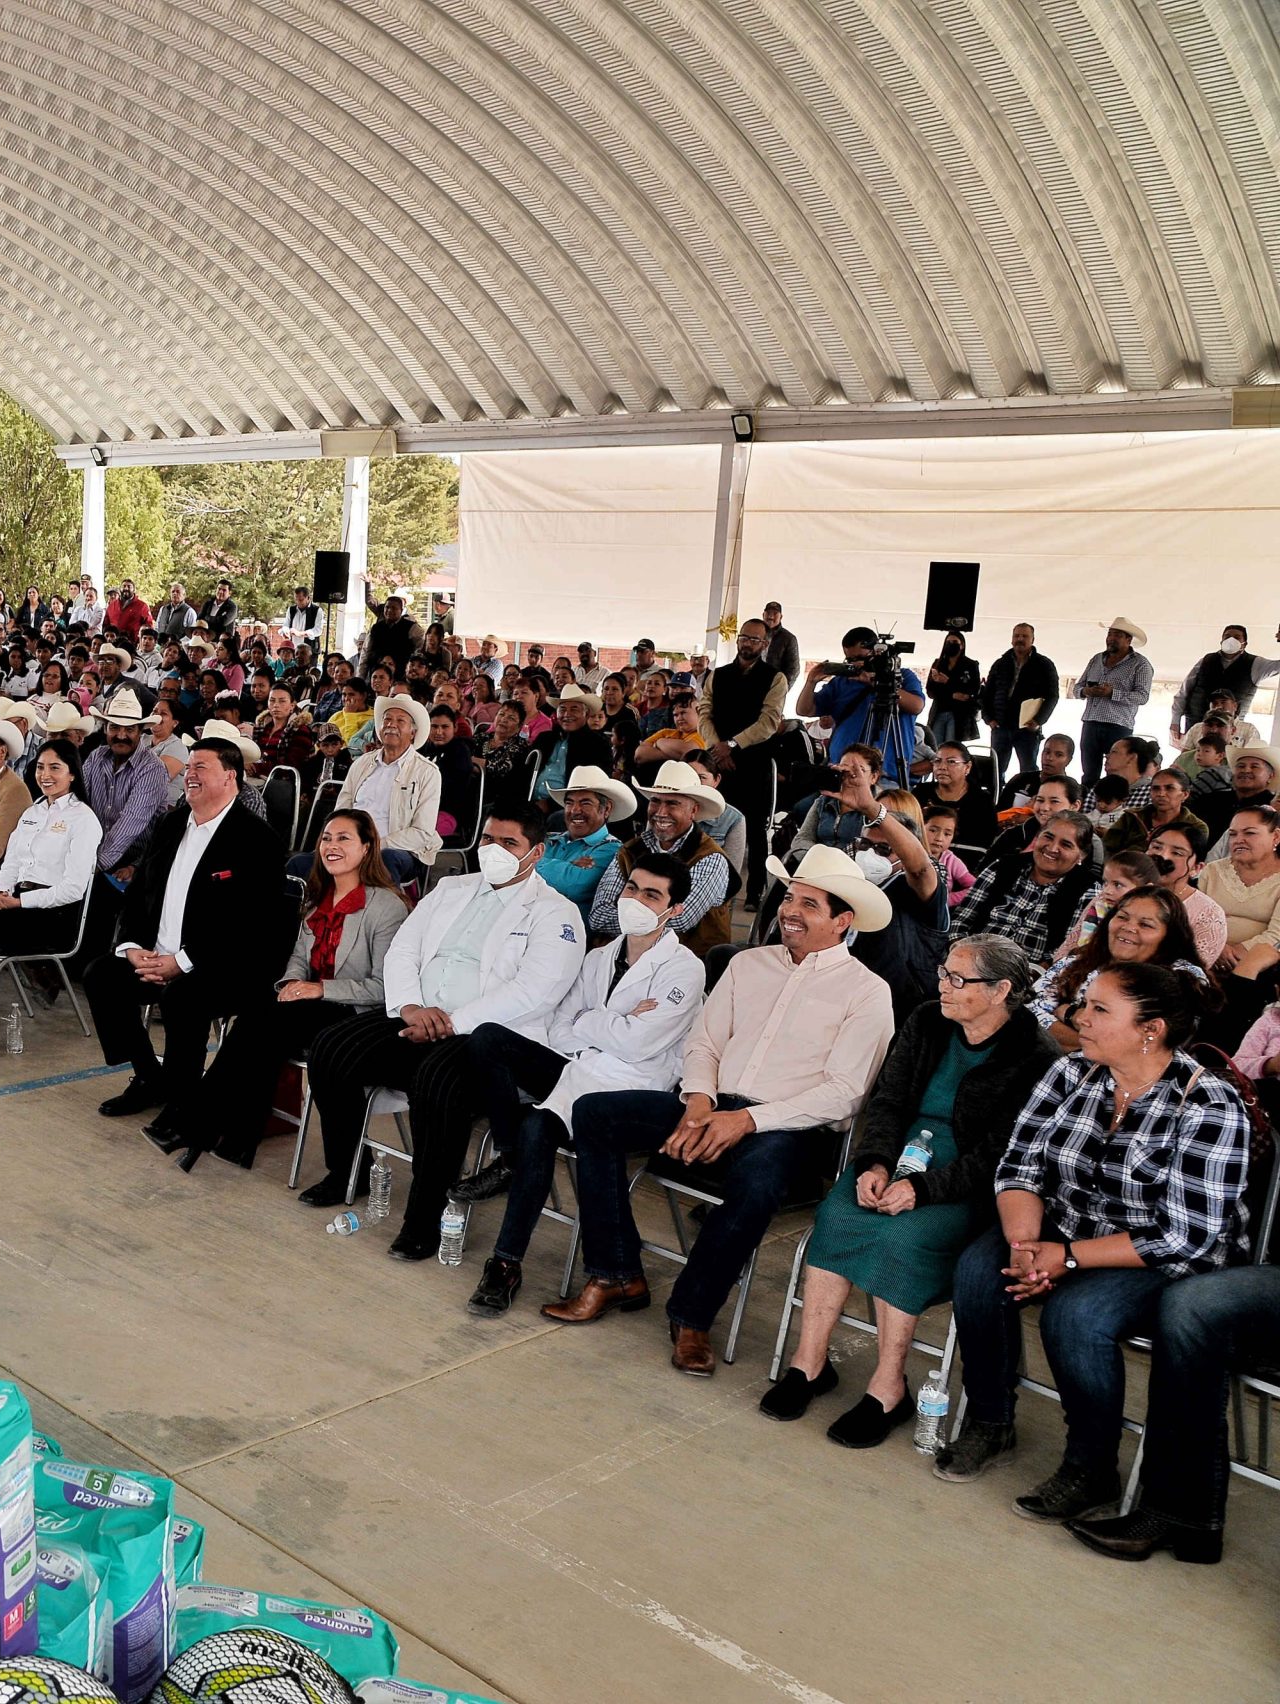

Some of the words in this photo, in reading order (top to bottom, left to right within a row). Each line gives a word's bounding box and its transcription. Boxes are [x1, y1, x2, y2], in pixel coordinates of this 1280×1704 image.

[1108, 814, 1116, 823] H
[92, 1480, 103, 1491] G
[112, 1484, 125, 1496] 10
[39, 1551, 53, 1565] 10
[9, 1608, 18, 1625] M
[334, 1609, 346, 1619] 10
[304, 1613, 368, 1635] Advanced
